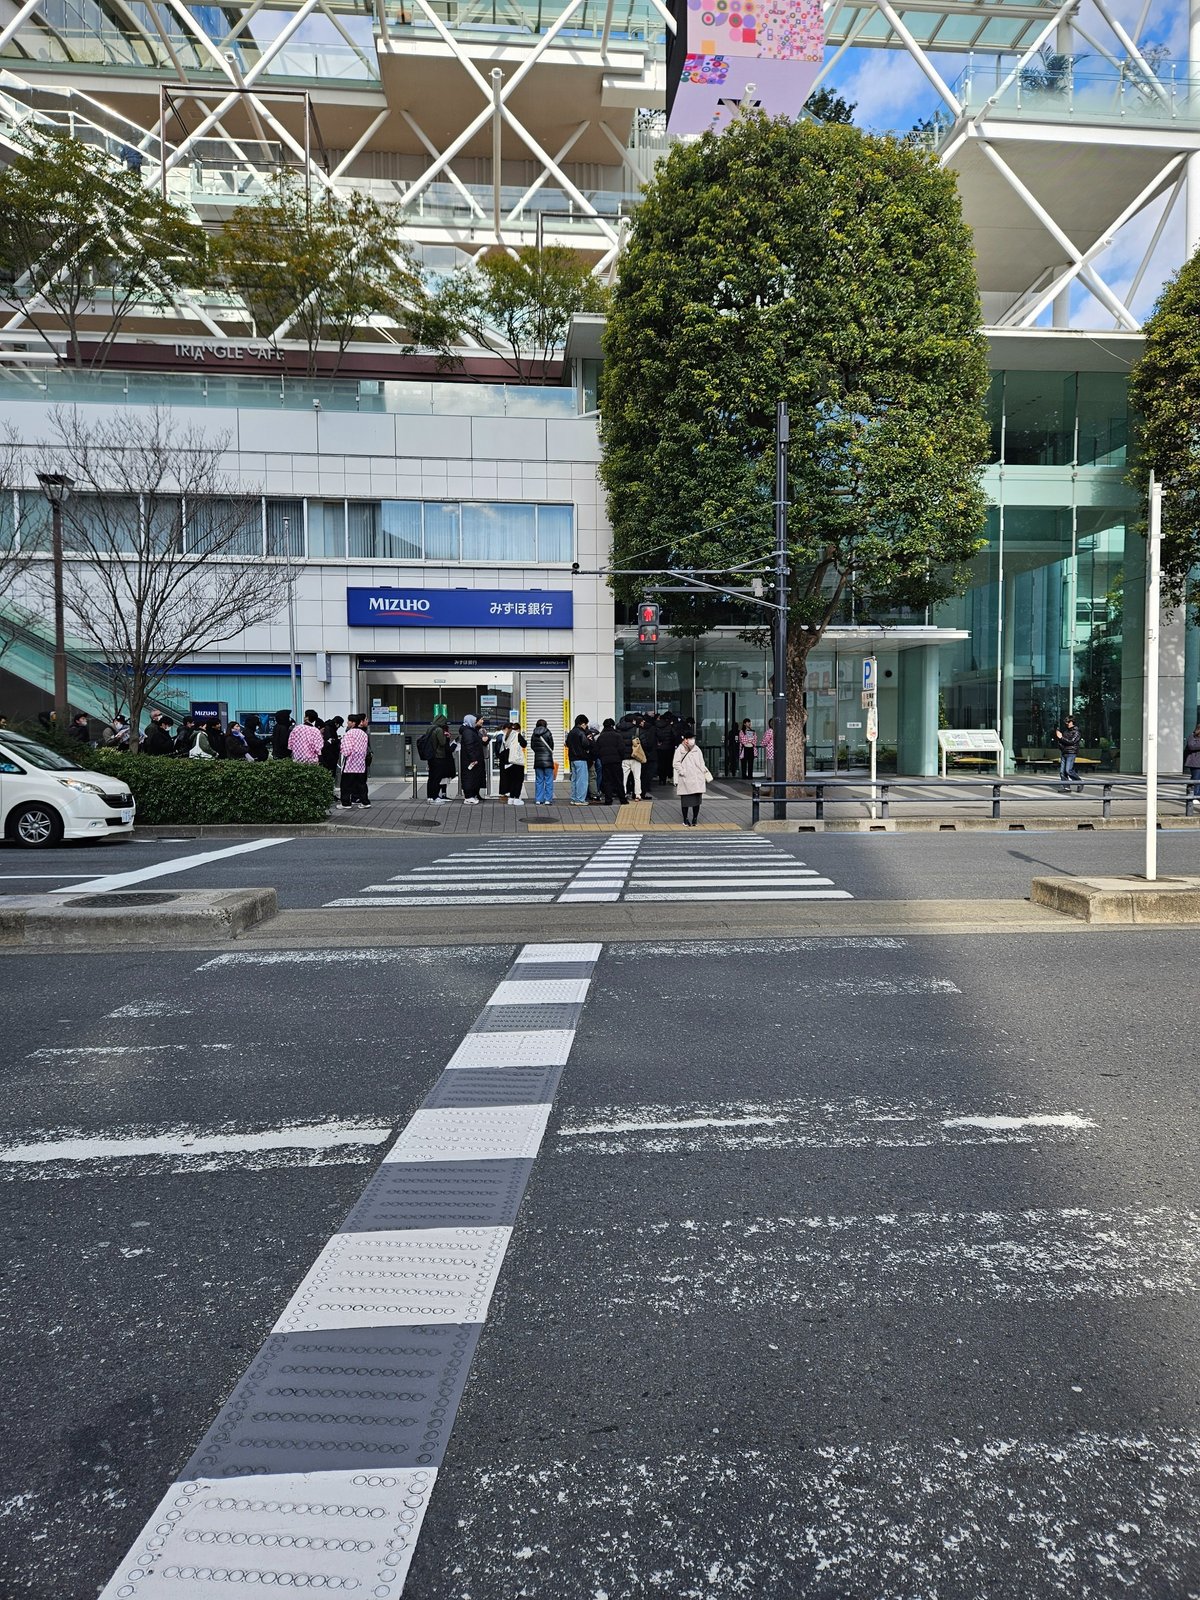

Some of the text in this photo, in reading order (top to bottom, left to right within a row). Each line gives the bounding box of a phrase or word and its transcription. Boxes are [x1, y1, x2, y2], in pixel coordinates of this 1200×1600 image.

[175, 341, 244, 361] TRIANGLE
[368, 597, 431, 612] MIZUHO
[489, 602, 553, 616] みずほ銀行
[864, 661, 871, 688] P
